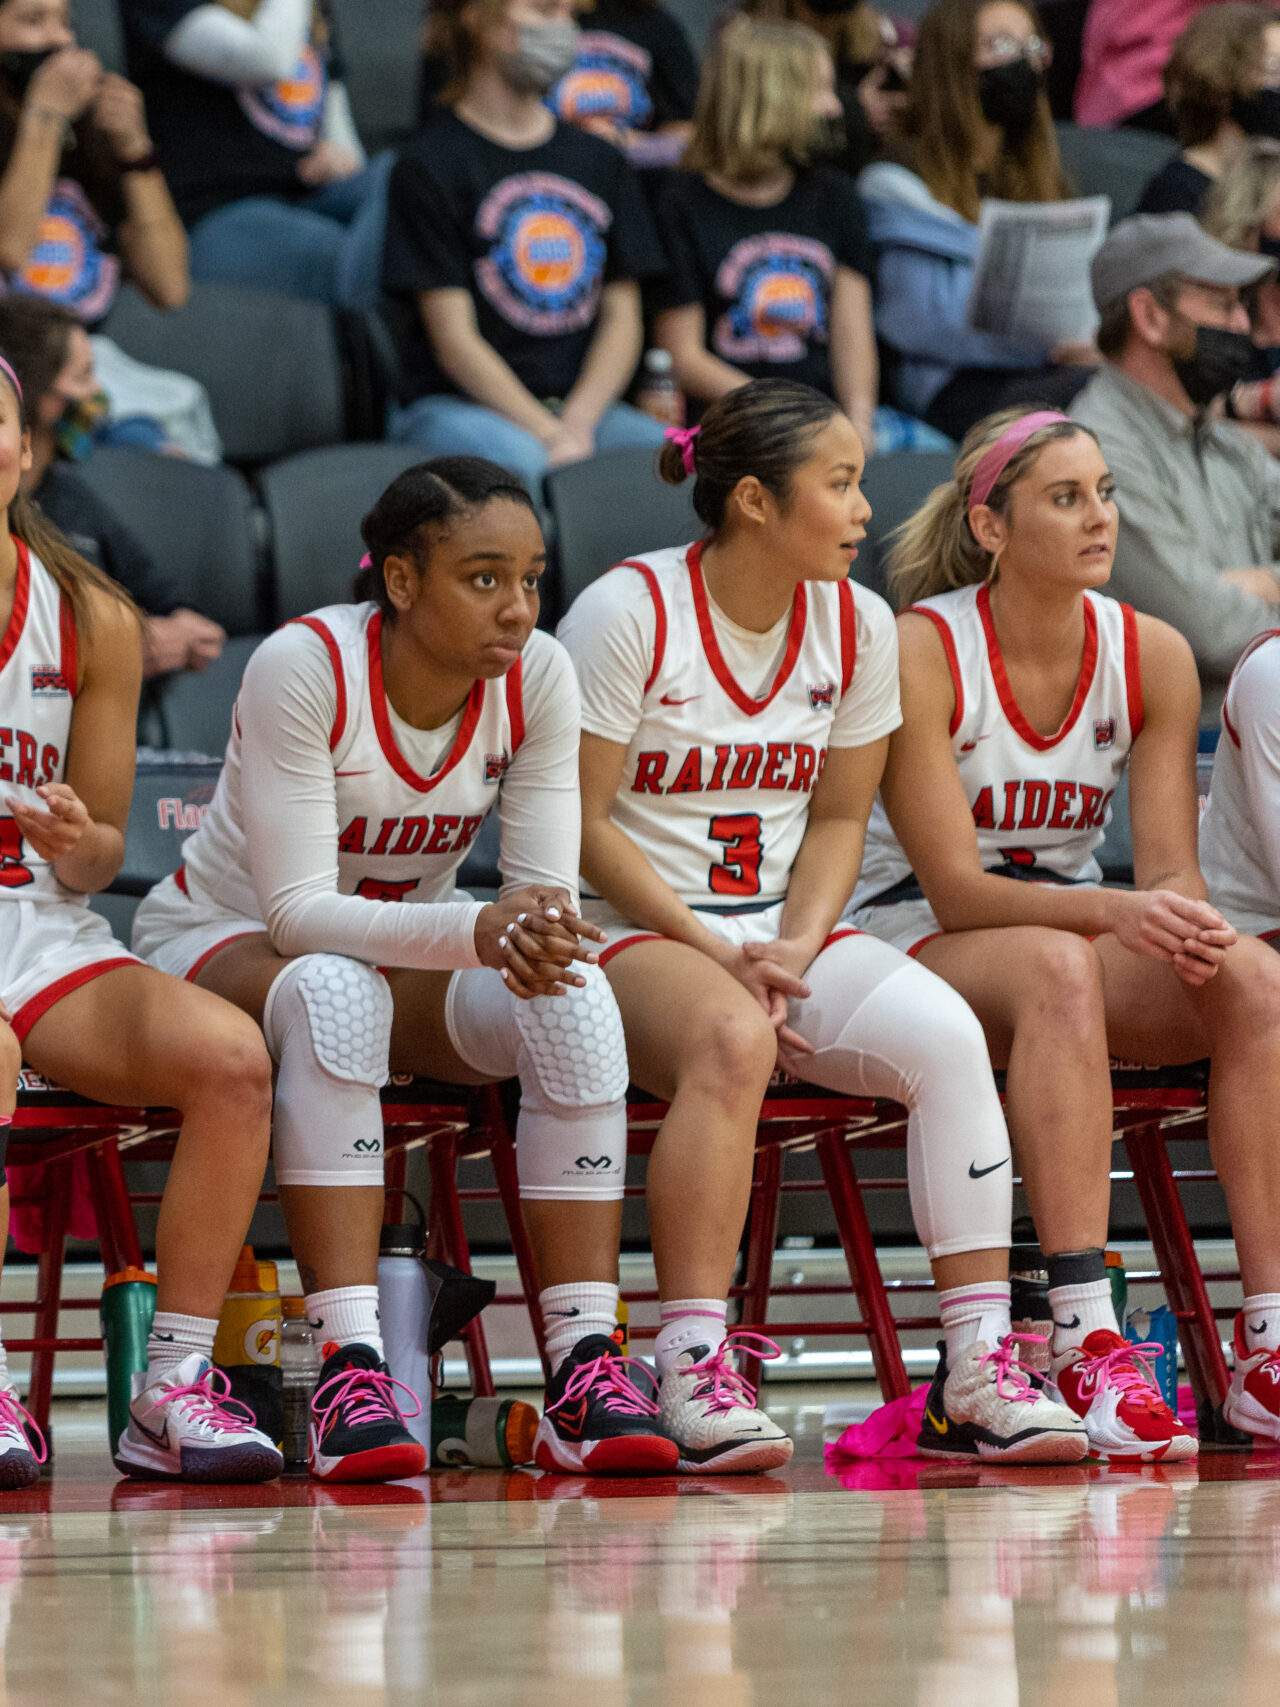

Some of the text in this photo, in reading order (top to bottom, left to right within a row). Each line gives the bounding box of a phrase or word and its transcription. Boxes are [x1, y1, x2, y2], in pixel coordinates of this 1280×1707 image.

[970, 779, 1115, 831] AIDER
[338, 808, 493, 856] AIDER
[708, 812, 765, 896] 3
[243, 1319, 281, 1365] G
